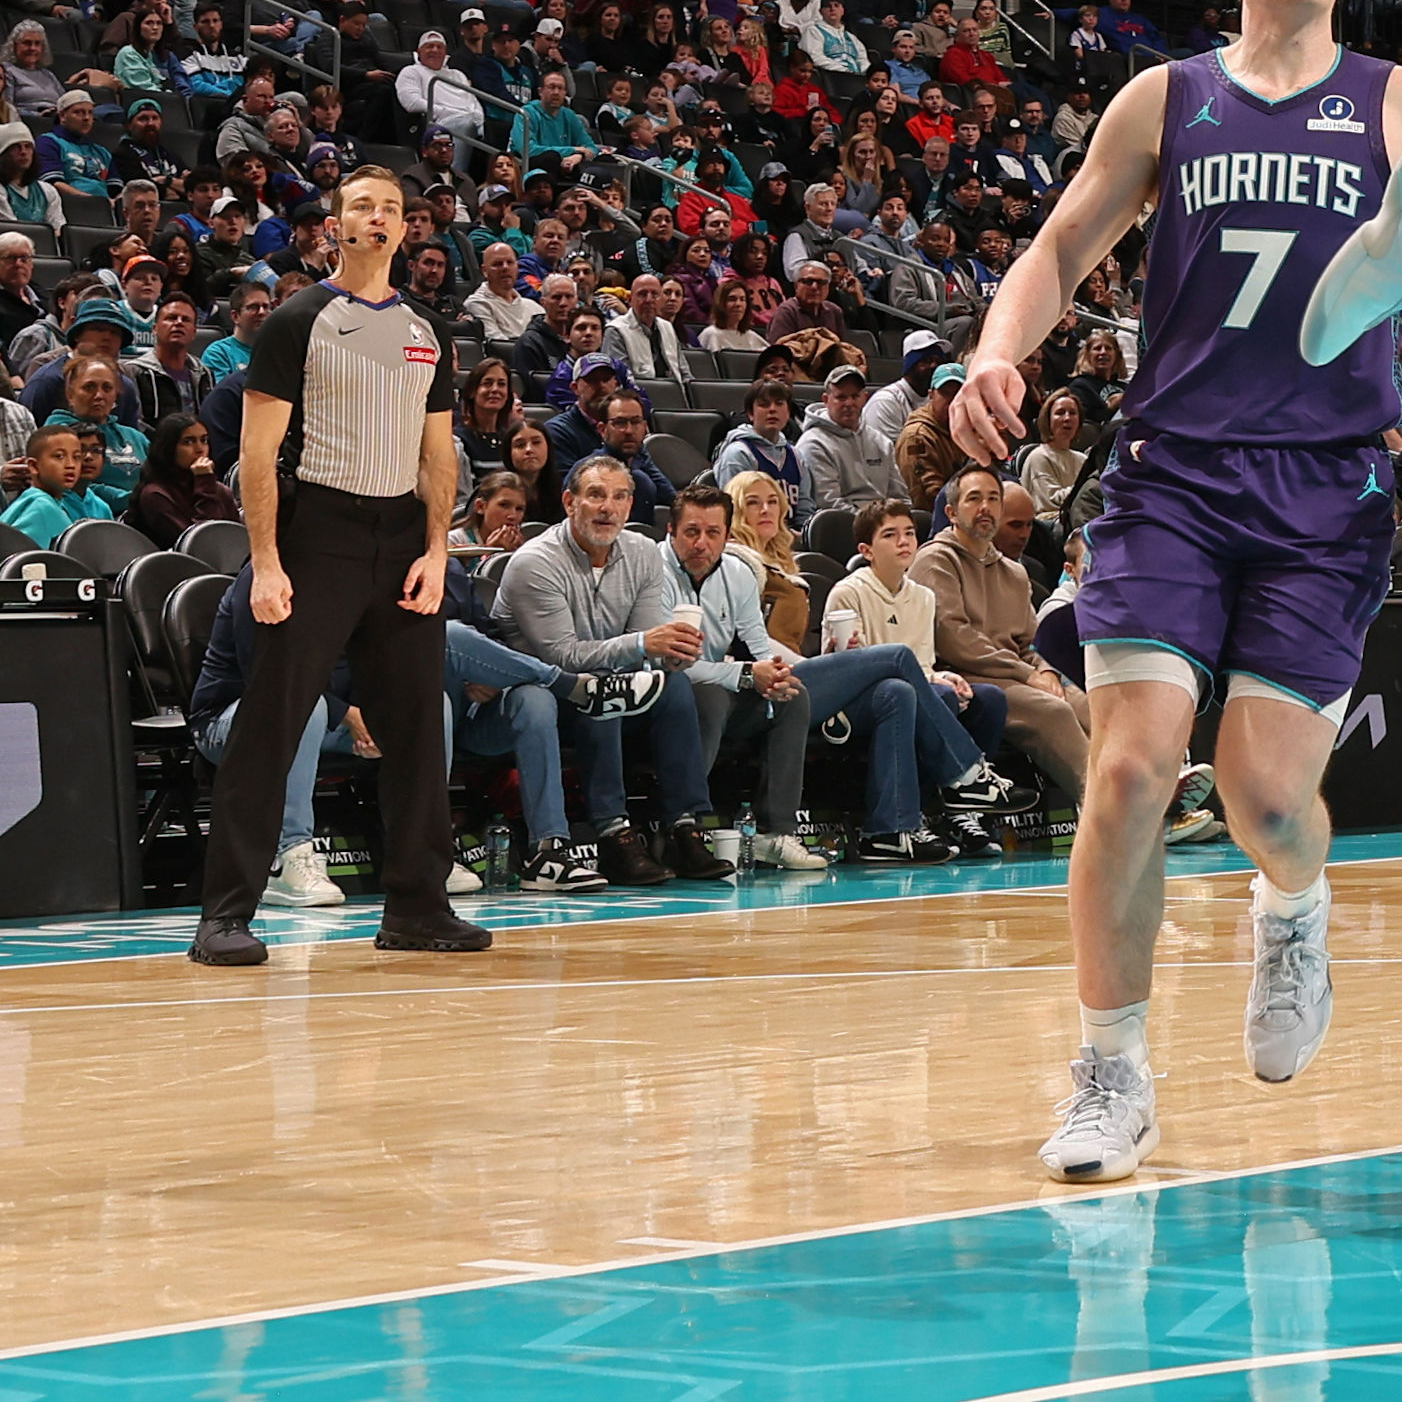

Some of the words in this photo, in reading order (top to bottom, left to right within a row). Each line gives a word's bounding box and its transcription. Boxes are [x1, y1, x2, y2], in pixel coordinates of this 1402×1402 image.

[1178, 151, 1366, 218] HORNETS
[1219, 227, 1300, 330] 7
[327, 849, 371, 864] VATION
